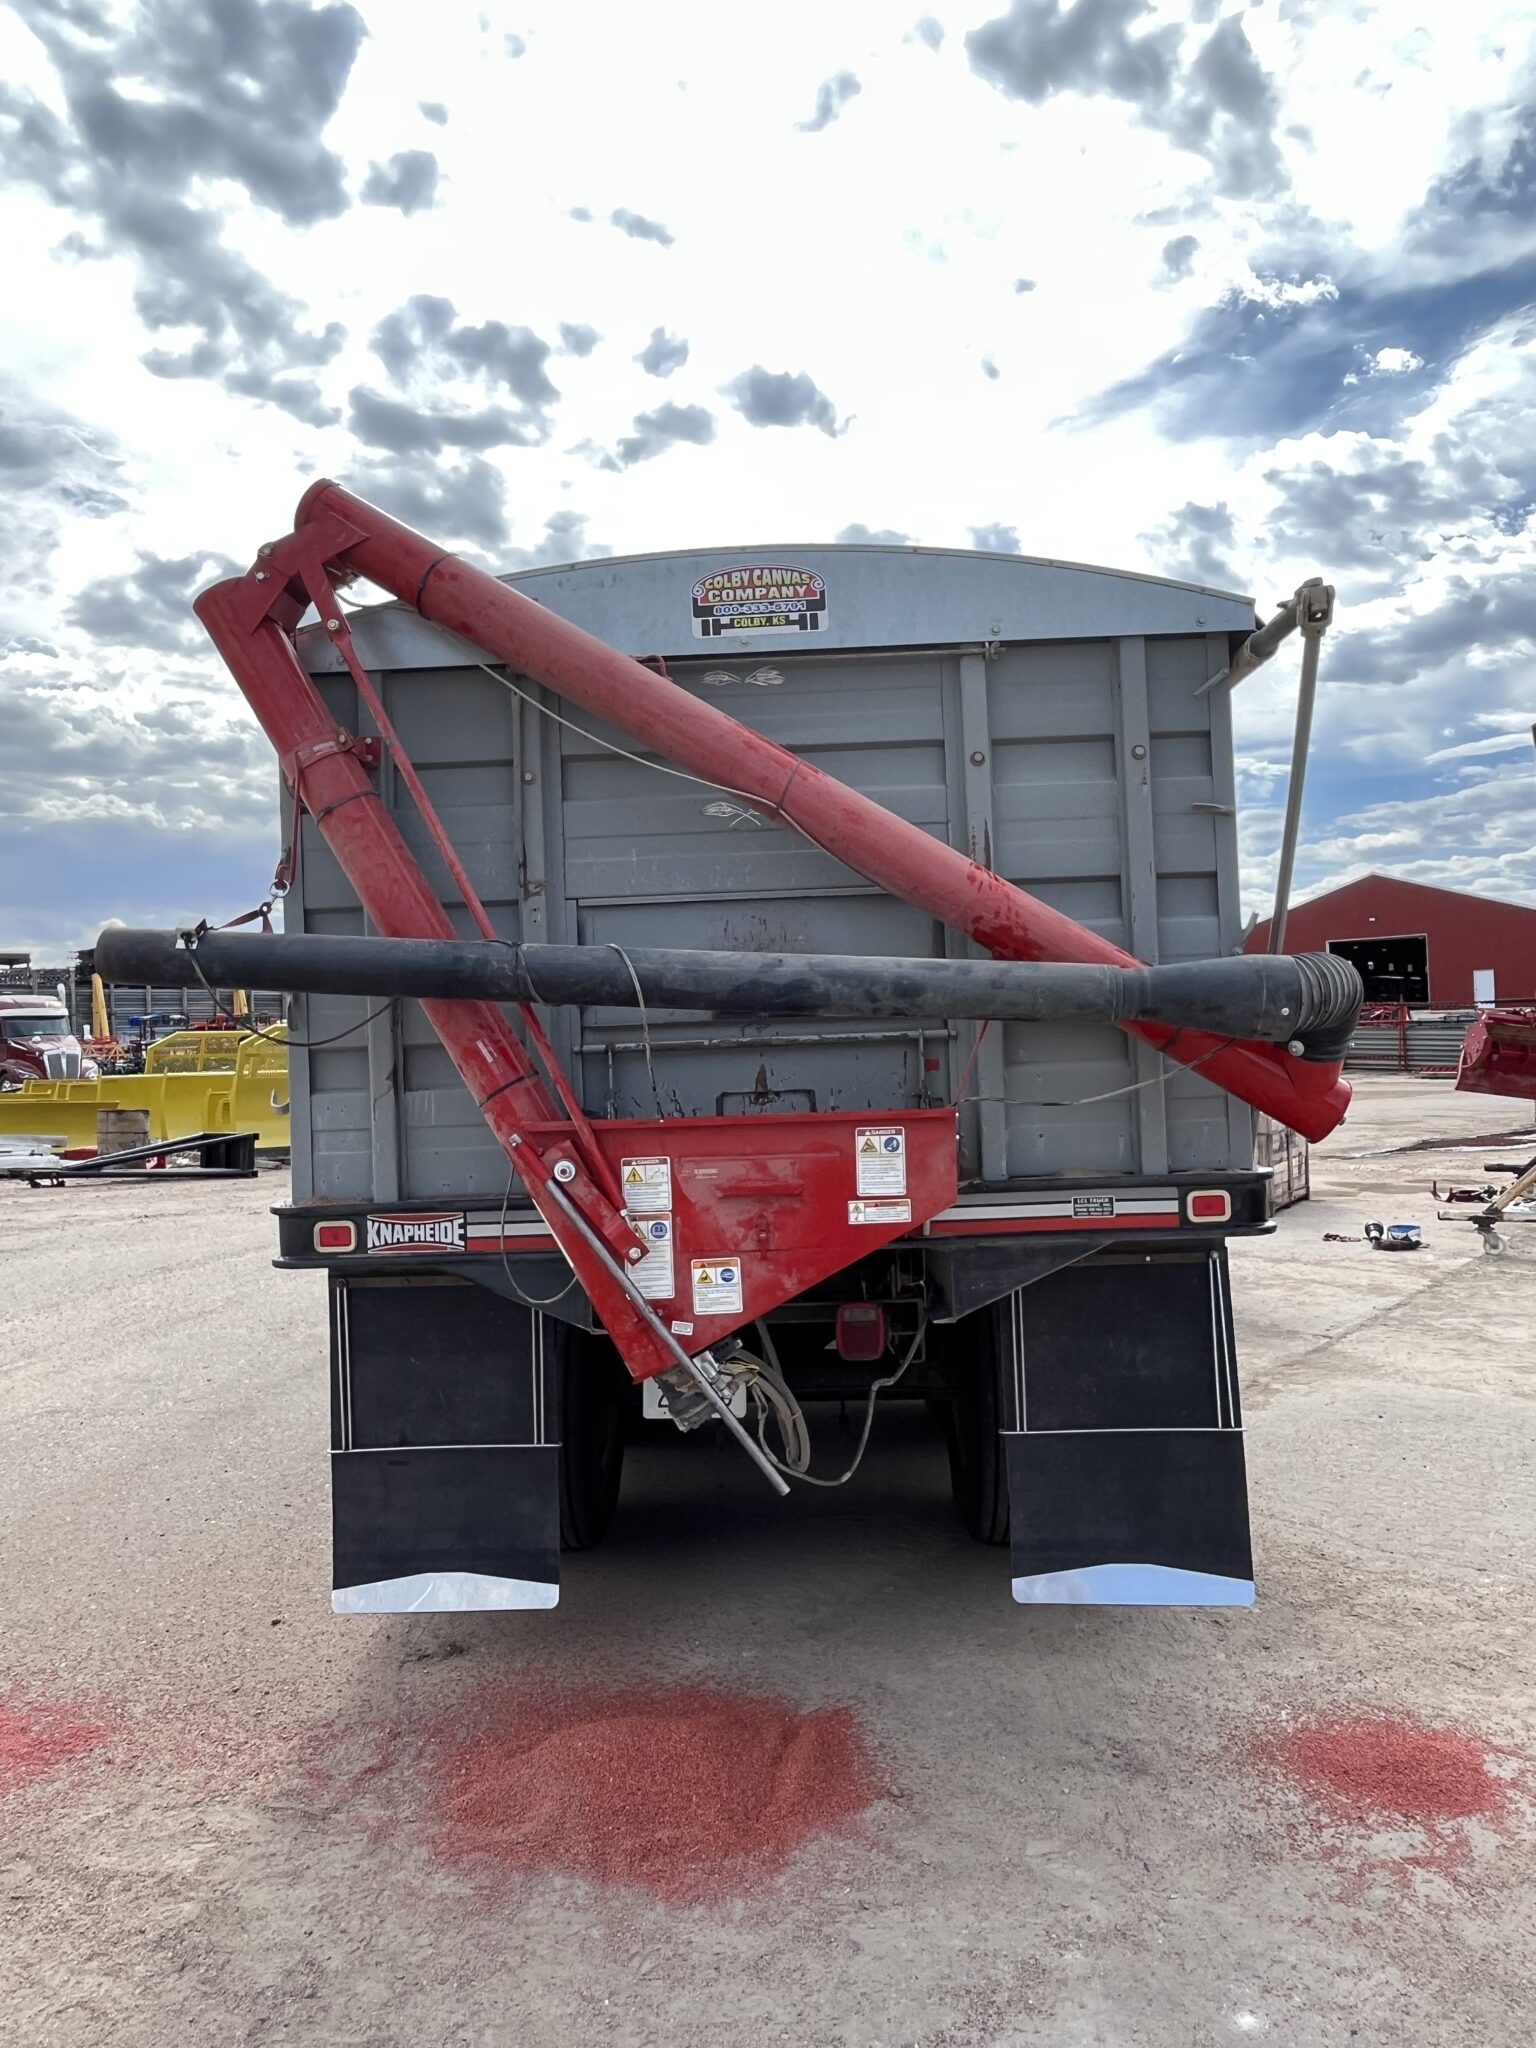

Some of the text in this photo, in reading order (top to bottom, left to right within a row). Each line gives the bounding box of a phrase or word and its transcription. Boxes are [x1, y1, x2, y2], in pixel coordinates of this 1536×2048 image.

[704, 568, 811, 589] COLBY CANVAS
[707, 585, 808, 602] COMPANY
[772, 615, 787, 626] KS
[366, 1218, 465, 1248] KNAPHEIDE
